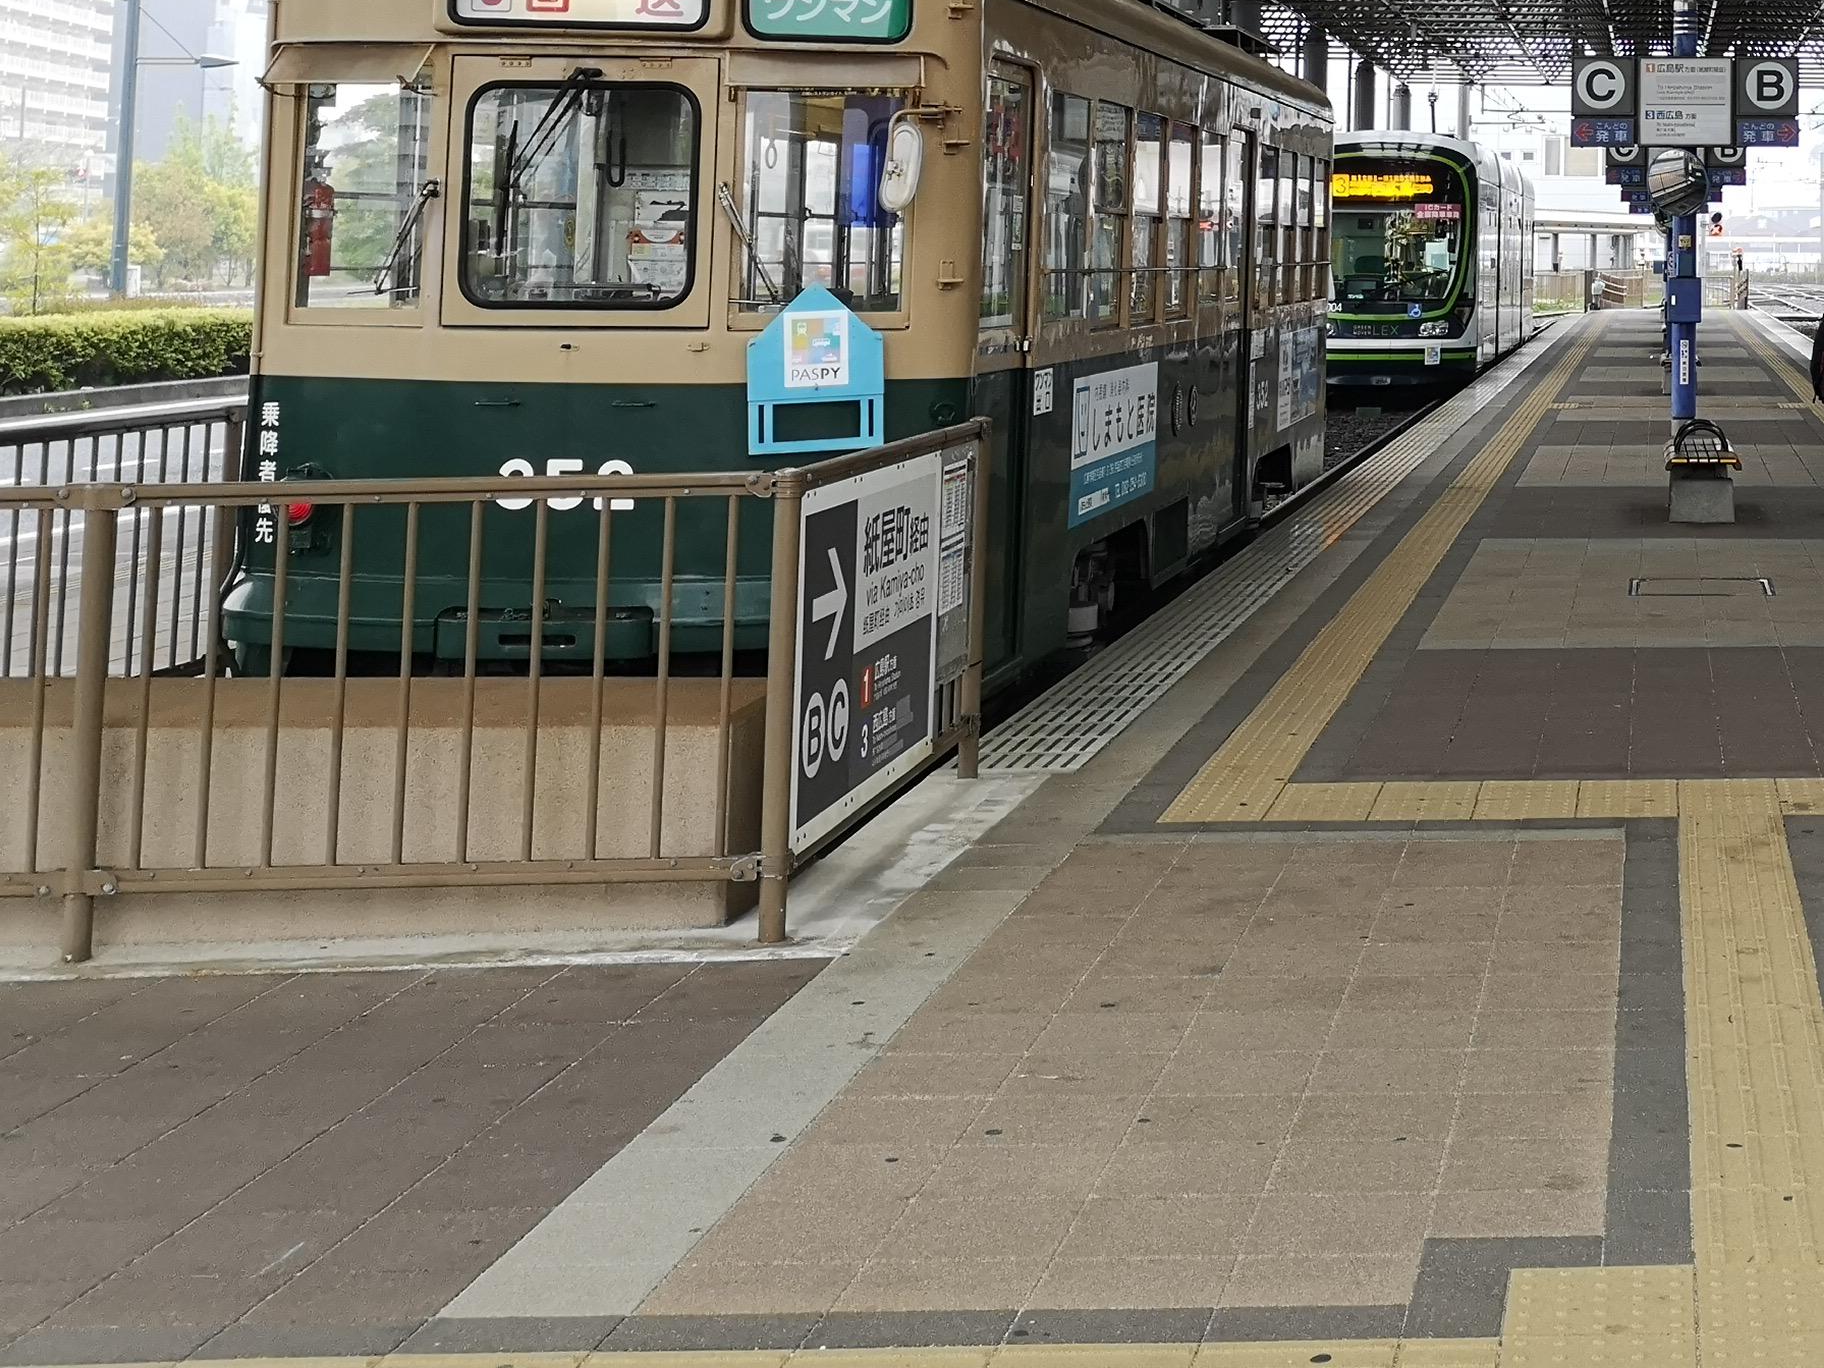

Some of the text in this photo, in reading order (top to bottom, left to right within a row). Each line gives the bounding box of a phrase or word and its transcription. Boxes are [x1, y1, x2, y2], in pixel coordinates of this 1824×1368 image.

[1586, 68, 1616, 101] C
[1756, 70, 1785, 101] B
[1595, 130, 1629, 143] 発車
[1596, 122, 1628, 130] こんどの
[1743, 122, 1775, 130] こんどの
[1743, 130, 1776, 143] 発車
[1335, 177, 1347, 194] 3
[1372, 325, 1400, 336] LEX
[791, 367, 841, 381] PASPY
[1092, 392, 1156, 452] しまもと医院
[863, 505, 929, 578] 紙屋町経由
[866, 563, 925, 607] via Kamiya-cho
[863, 668, 869, 703] 1
[808, 705, 821, 768] B
[831, 690, 846, 751] C
[861, 723, 869, 759] 3
